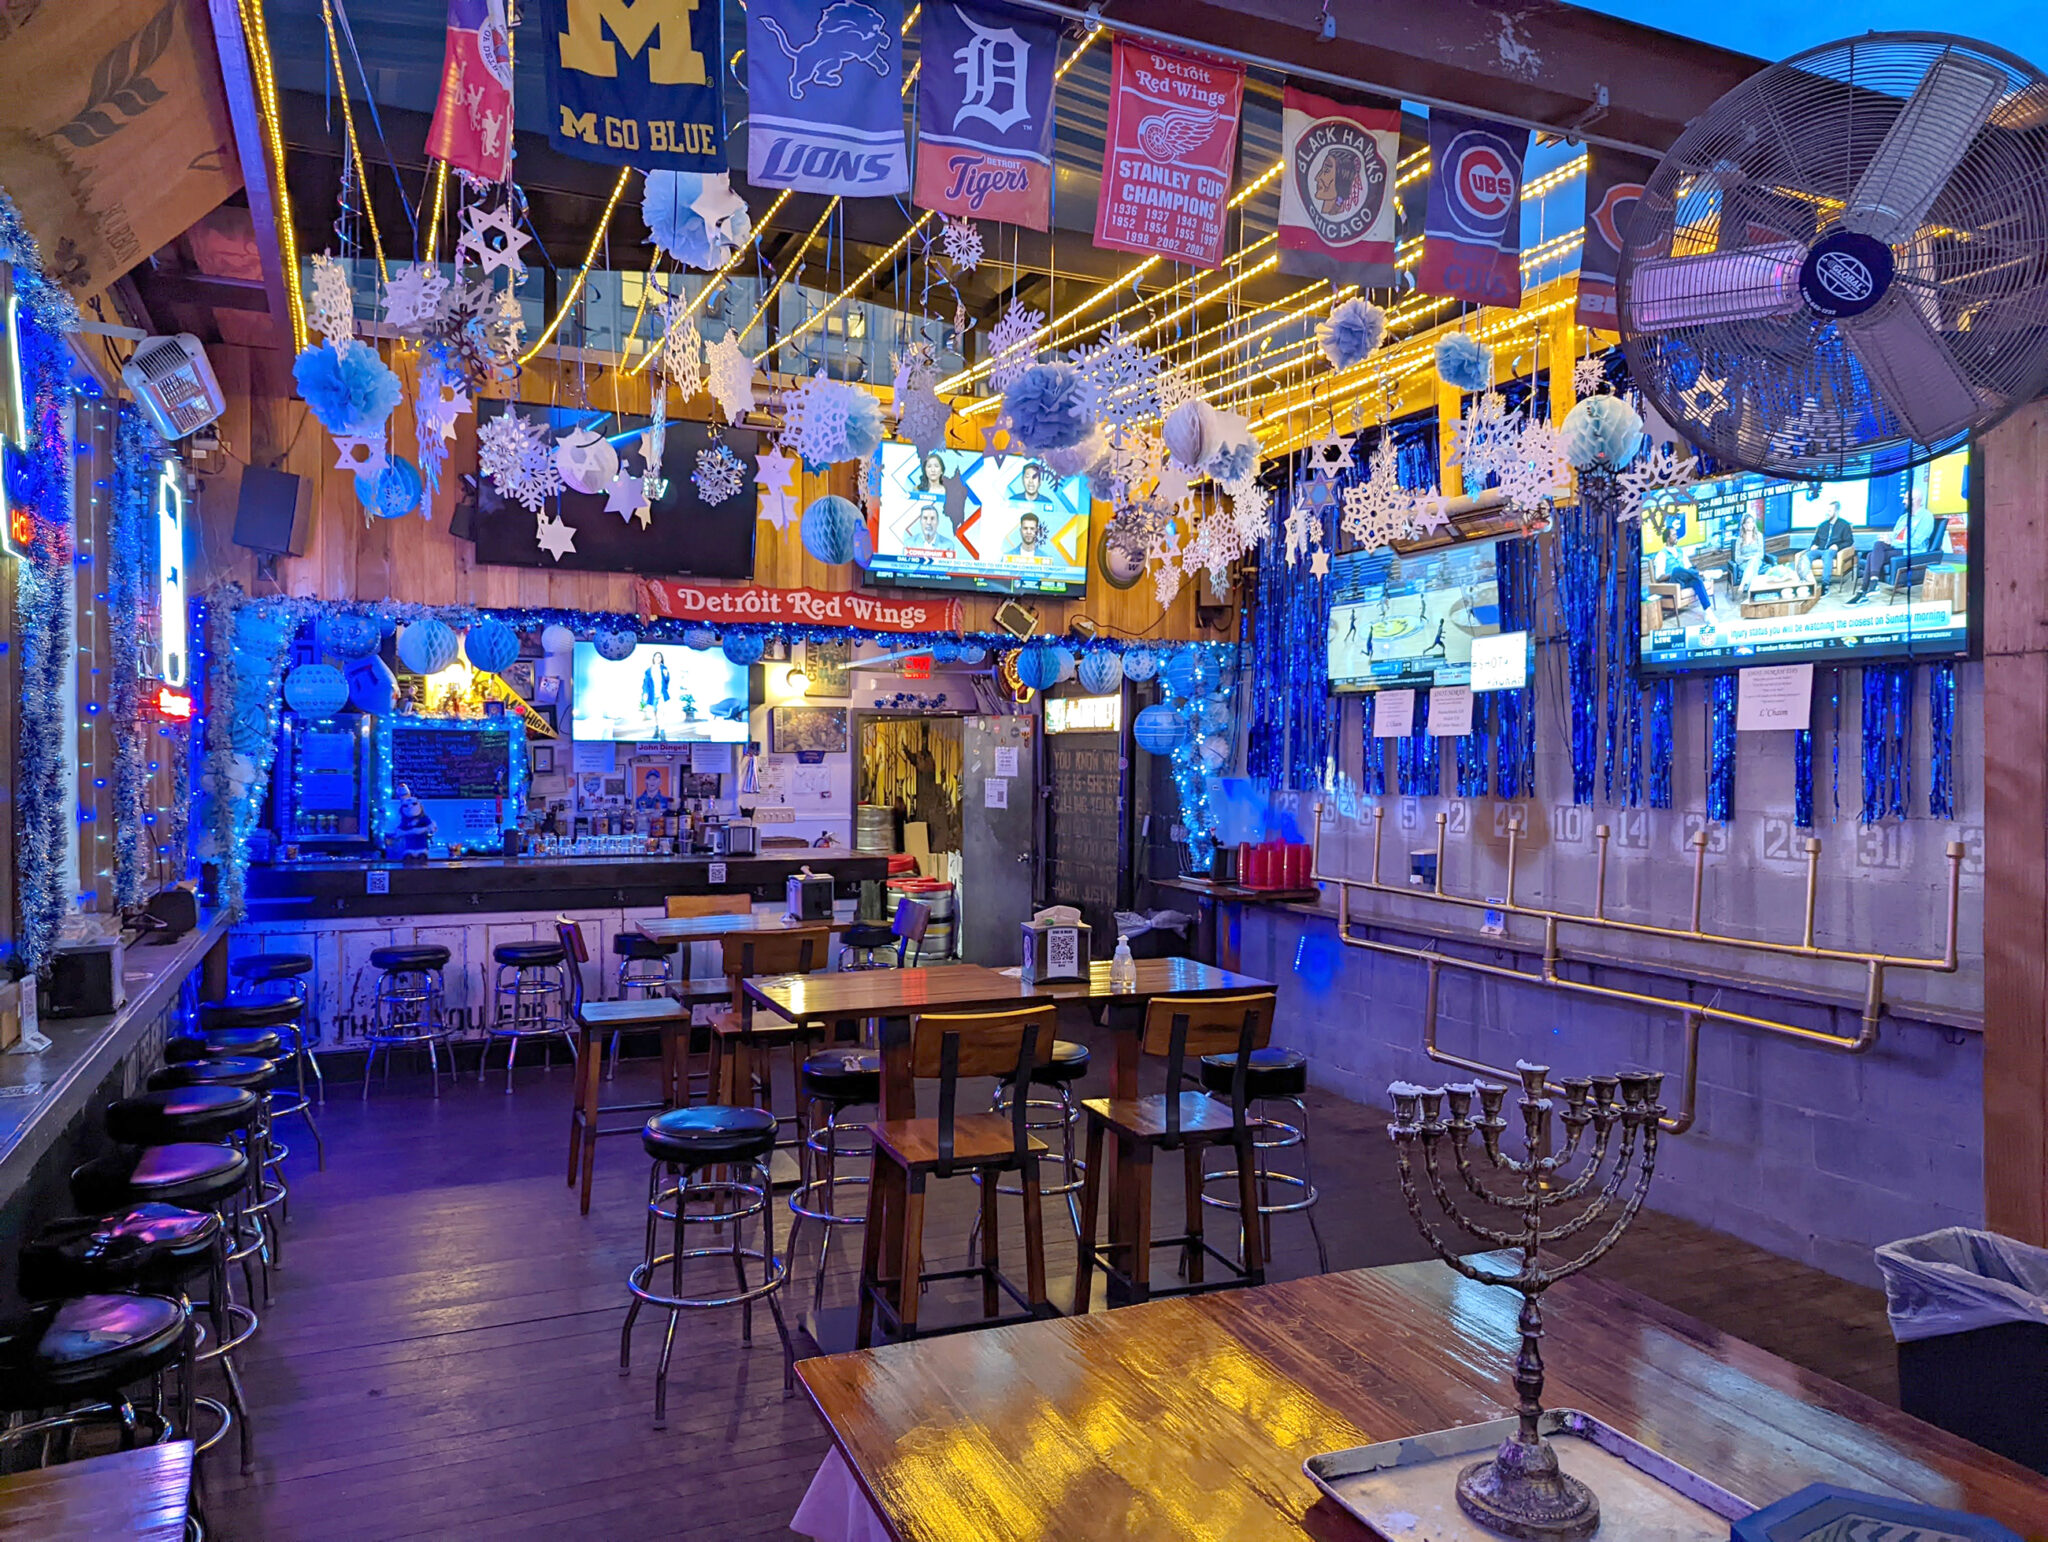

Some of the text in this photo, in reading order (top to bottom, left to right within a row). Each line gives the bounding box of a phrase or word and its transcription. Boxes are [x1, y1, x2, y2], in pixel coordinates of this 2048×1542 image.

[952, 3, 1030, 134] D
[1151, 54, 1212, 84] Detroit
[1135, 69, 1225, 107] Red Wings
[560, 104, 716, 155] M GO BLUE
[758, 136, 894, 183] LIONS
[986, 157, 1021, 169] DETROIT
[1298, 127, 1384, 183] BLACK HAWKS
[945, 155, 1029, 211] Tigers
[1119, 160, 1224, 199] STANLEY CUP
[1122, 183, 1216, 220] CHAMPIONS
[1112, 215, 1136, 229] 1952
[1144, 221, 1167, 234] 1954
[1175, 227, 1195, 240] 1955
[1113, 203, 1219, 234] 1936 1937 1943 1950
[1309, 205, 1372, 238] CHICAGO
[1126, 231, 1149, 244] 1998
[1157, 237, 1180, 250] 2002
[1832, 264, 1863, 290] GLOBAL
[1698, 504, 1745, 520] THAT INJURY TO
[1710, 496, 1722, 507] AND
[1723, 493, 1739, 504] THAT
[1740, 493, 1747, 501] IS
[1747, 489, 1763, 501] WHY
[678, 589, 927, 629] Detroit Red Wings
[1885, 612, 1912, 625] Sunday
[1913, 609, 1946, 622] morning
[660, 743, 688, 752] Dingell
[1054, 751, 1070, 770] YOU
[1403, 800, 1415, 828] 5
[1451, 801, 1465, 832] 2
[1555, 808, 1582, 840] 10
[1619, 810, 1648, 846] 14
[1685, 814, 1727, 852] 23
[1859, 824, 1900, 866] 31
[434, 1005, 484, 1033] YOU
[498, 1001, 548, 1030] FOR
